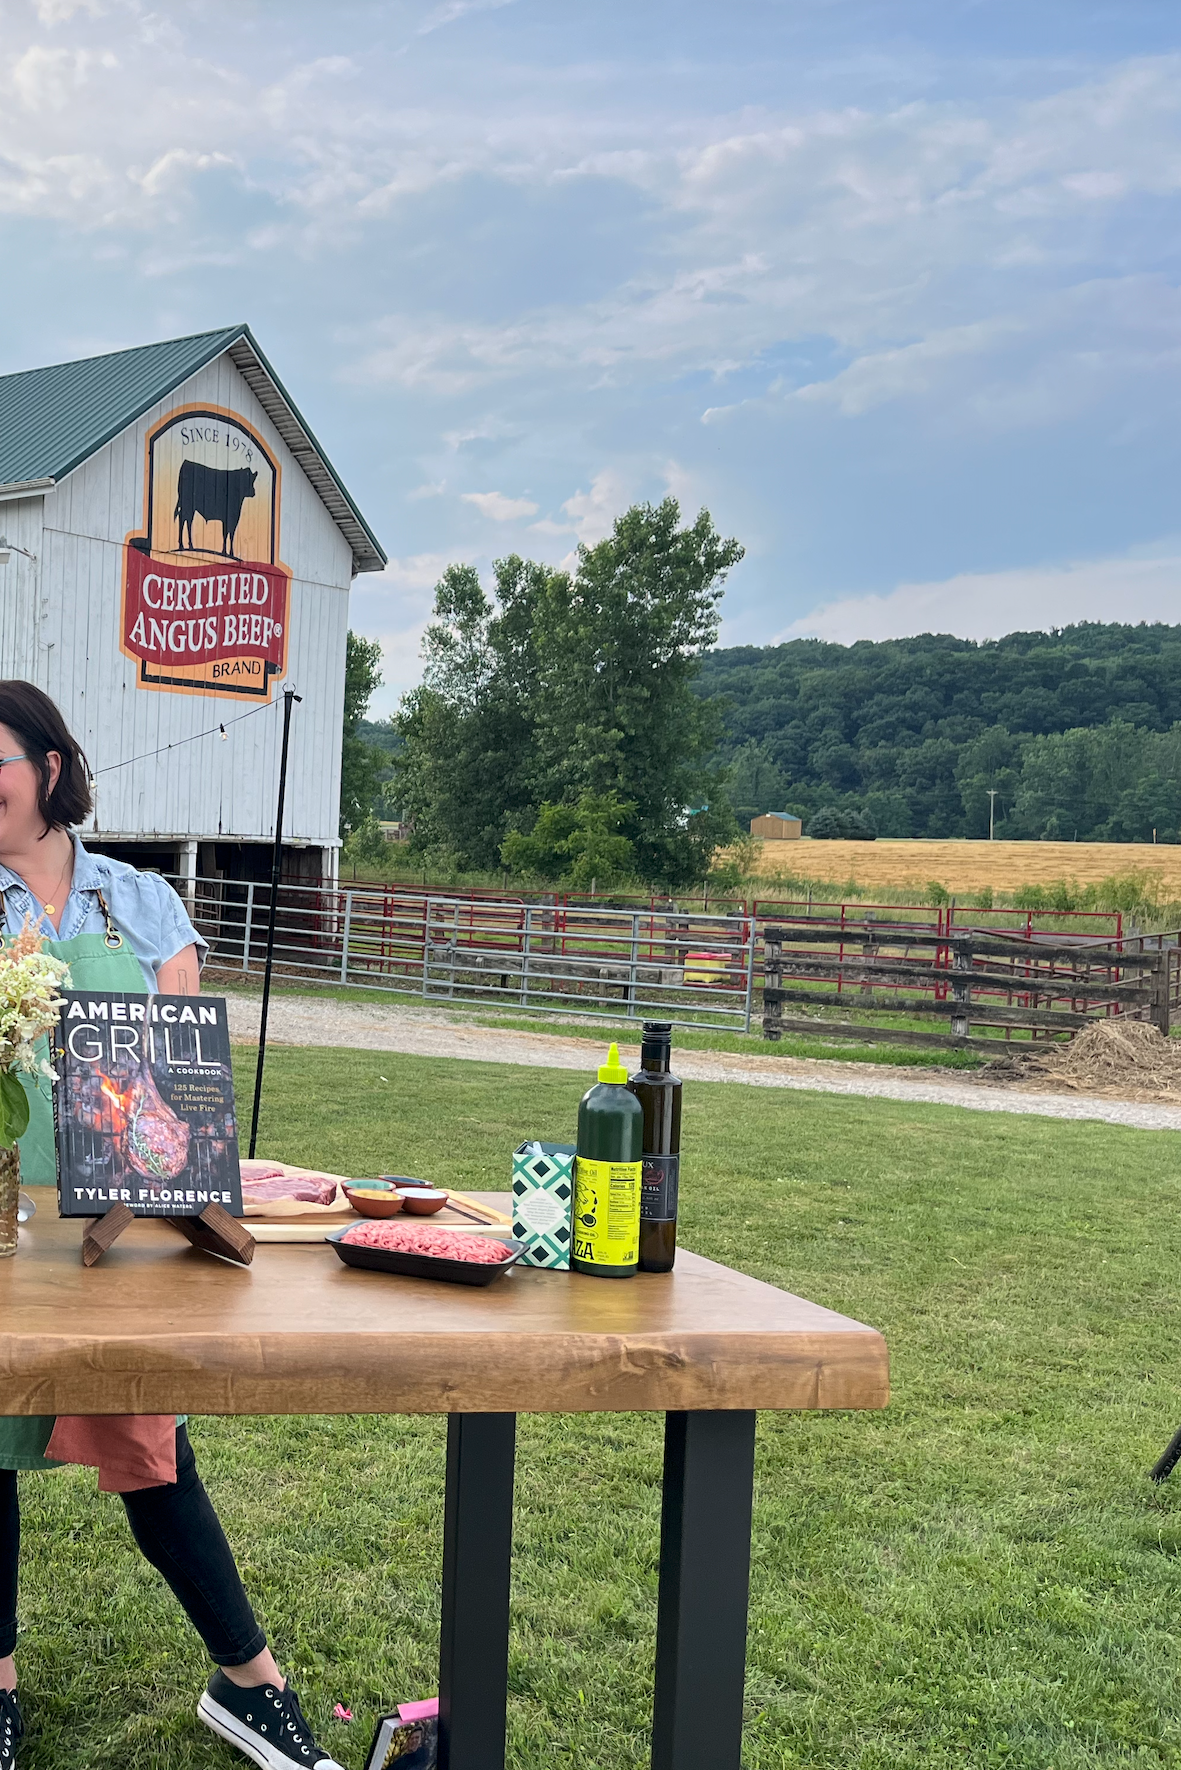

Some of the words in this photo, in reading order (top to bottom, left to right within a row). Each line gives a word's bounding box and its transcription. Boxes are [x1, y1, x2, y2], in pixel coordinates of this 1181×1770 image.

[225, 434, 254, 462] 1978
[142, 573, 269, 611] CERTIFIED
[129, 611, 218, 652] ANGUS
[212, 661, 261, 678] BRAND
[67, 1001, 218, 1025] AMERICAN
[68, 1023, 222, 1067] GRILL
[176, 1068, 222, 1076] COOKBOOK
[174, 1083, 188, 1092] 125
[189, 1084, 221, 1094] Recipes
[170, 1093, 183, 1101] for
[184, 1093, 225, 1104] Mastering
[180, 1103, 198, 1111] Live
[199, 1104, 216, 1112] Fire
[74, 1187, 131, 1200] TYLER
[139, 1188, 232, 1203] FLORENCE
